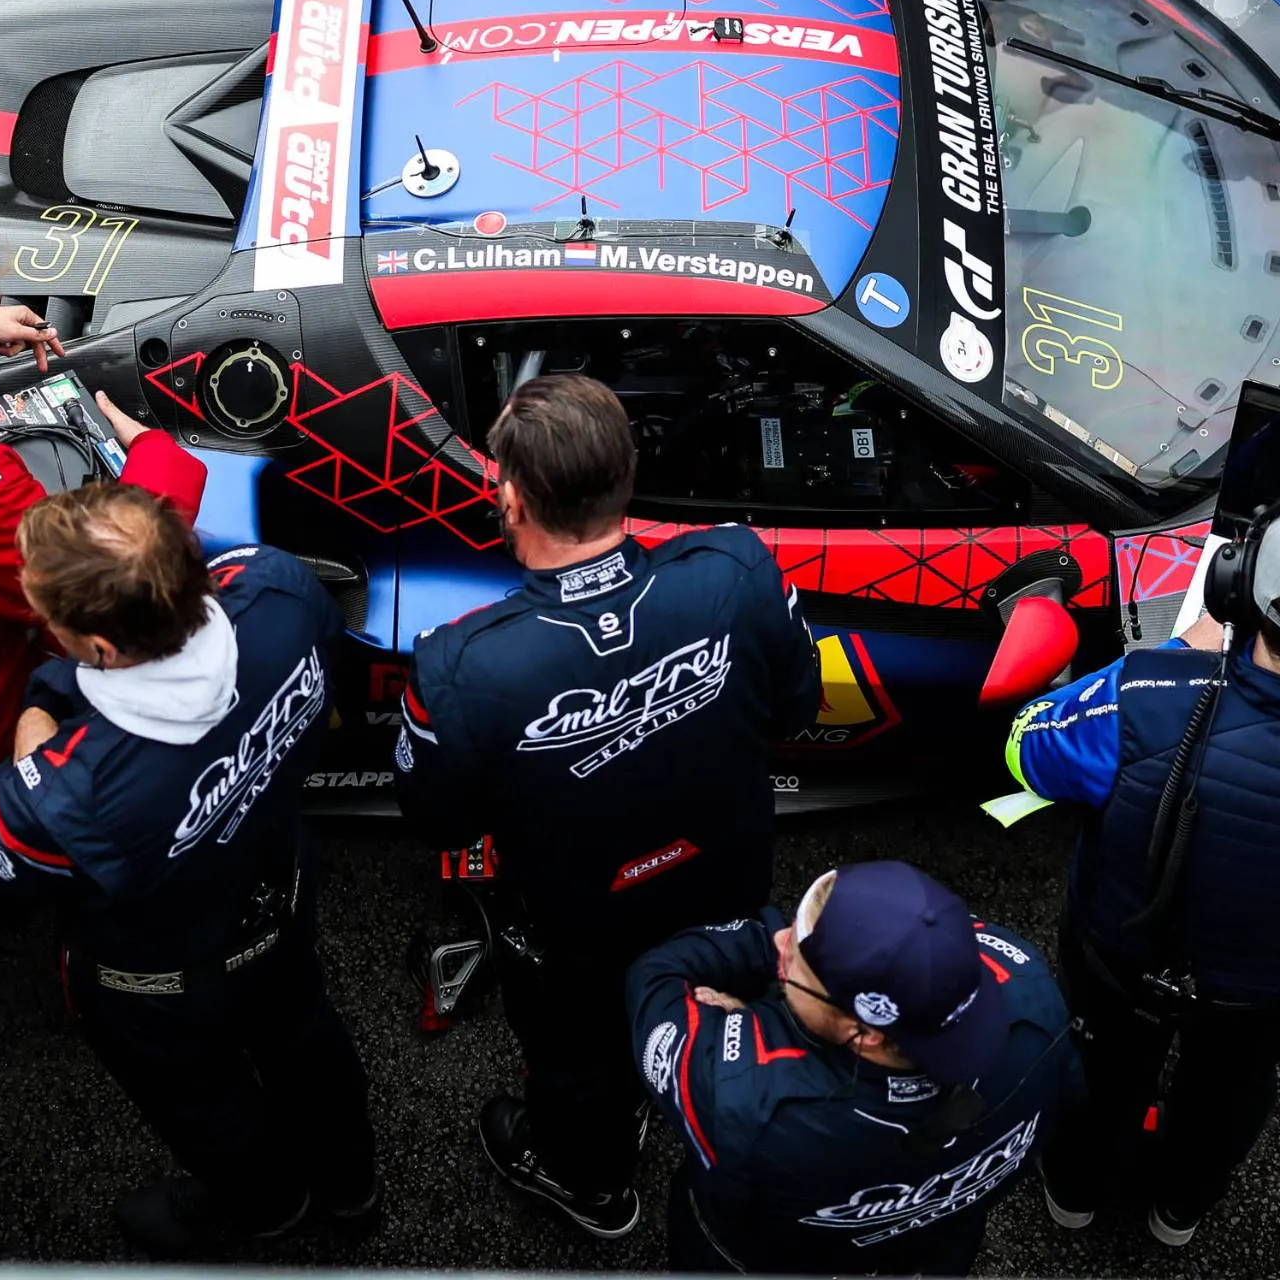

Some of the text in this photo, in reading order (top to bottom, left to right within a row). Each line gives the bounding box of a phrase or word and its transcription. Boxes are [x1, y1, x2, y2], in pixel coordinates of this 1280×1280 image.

[291, 0, 327, 106] auto
[440, 16, 864, 60] VERSAPPEN.COM
[970, 70, 993, 141] DRIVING
[278, 132, 315, 260] auto
[943, 122, 984, 214] GRAN
[978, 144, 997, 184] REAL
[983, 186, 1001, 217] THE
[13, 205, 140, 297] 31
[413, 243, 815, 295] C.Lulham M.Verstappen
[1022, 287, 1124, 390] 31
[857, 431, 870, 456] OB1
[524, 634, 730, 740] Emil Frey
[175, 644, 324, 840] Emil Frey
[599, 696, 700, 763] RACING
[303, 771, 395, 788] STAPP
[623, 847, 683, 880] sparco
[975, 932, 1031, 966] sparco
[722, 1012, 743, 1063] sparco
[815, 1120, 1040, 1223] Emil Frey
